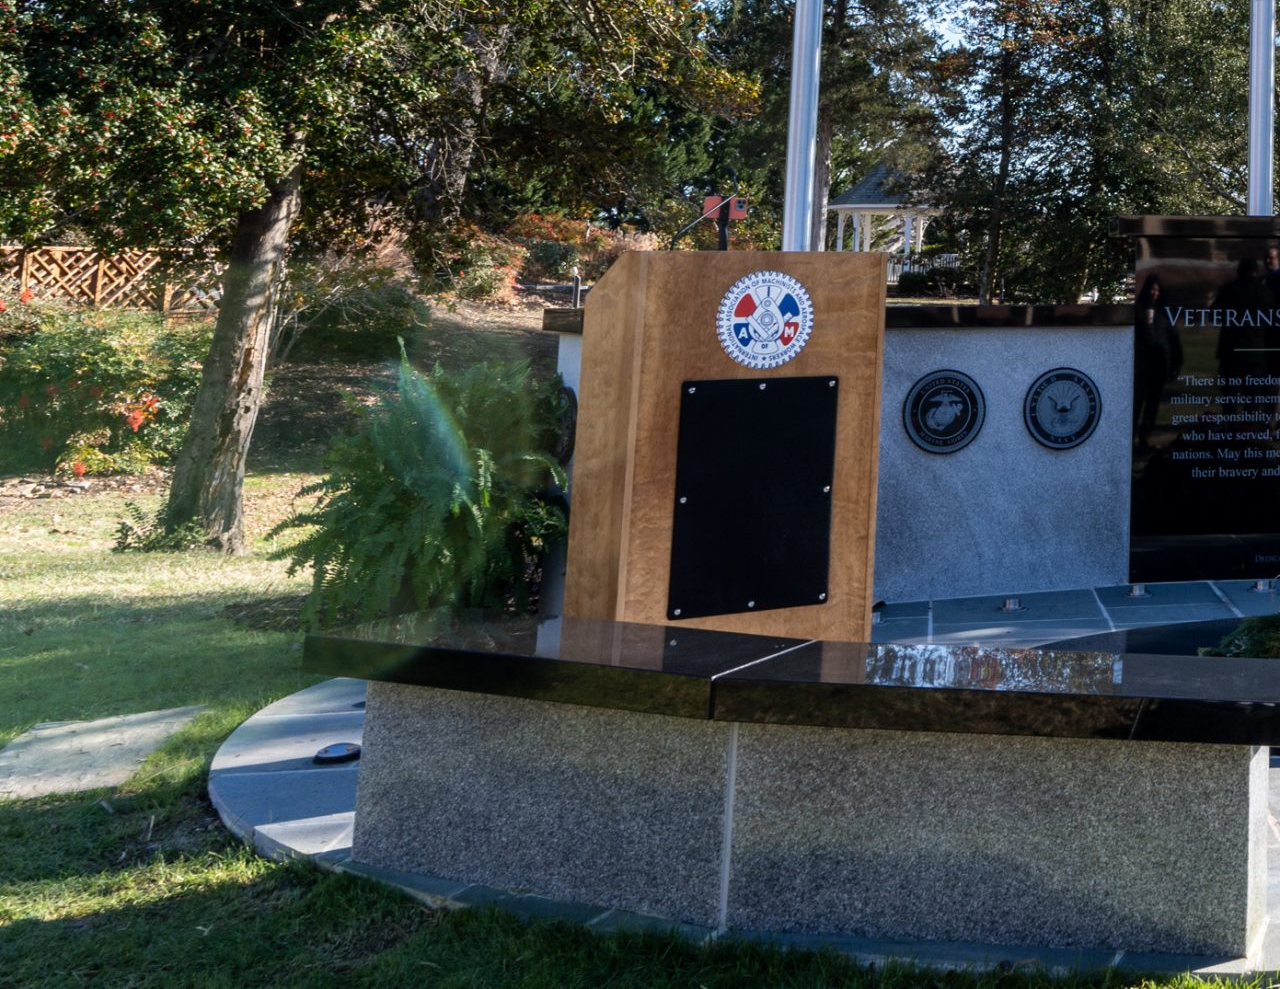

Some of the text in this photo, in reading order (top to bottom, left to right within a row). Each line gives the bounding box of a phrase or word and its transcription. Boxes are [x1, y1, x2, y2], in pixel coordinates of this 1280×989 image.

[726, 278, 808, 361] INTERNATIONAL ASSOCIATION OF MACHINISTS AND AEROSPACE WORKERS
[738, 327, 749, 339] A
[784, 326, 795, 338] M
[1217, 375, 1226, 386] is
[1229, 378, 1242, 386] no
[1170, 393, 1212, 407] military
[1215, 393, 1252, 404] service
[1172, 414, 1199, 425] great
[1201, 411, 1272, 424] responsibility
[1182, 430, 1205, 441] who
[1208, 430, 1233, 441] have
[1217, 448, 1241, 461] May
[1244, 447, 1263, 459] this
[1192, 467, 1216, 478] their
[1218, 466, 1259, 479] bravery
[1261, 465, 1280, 476] and
